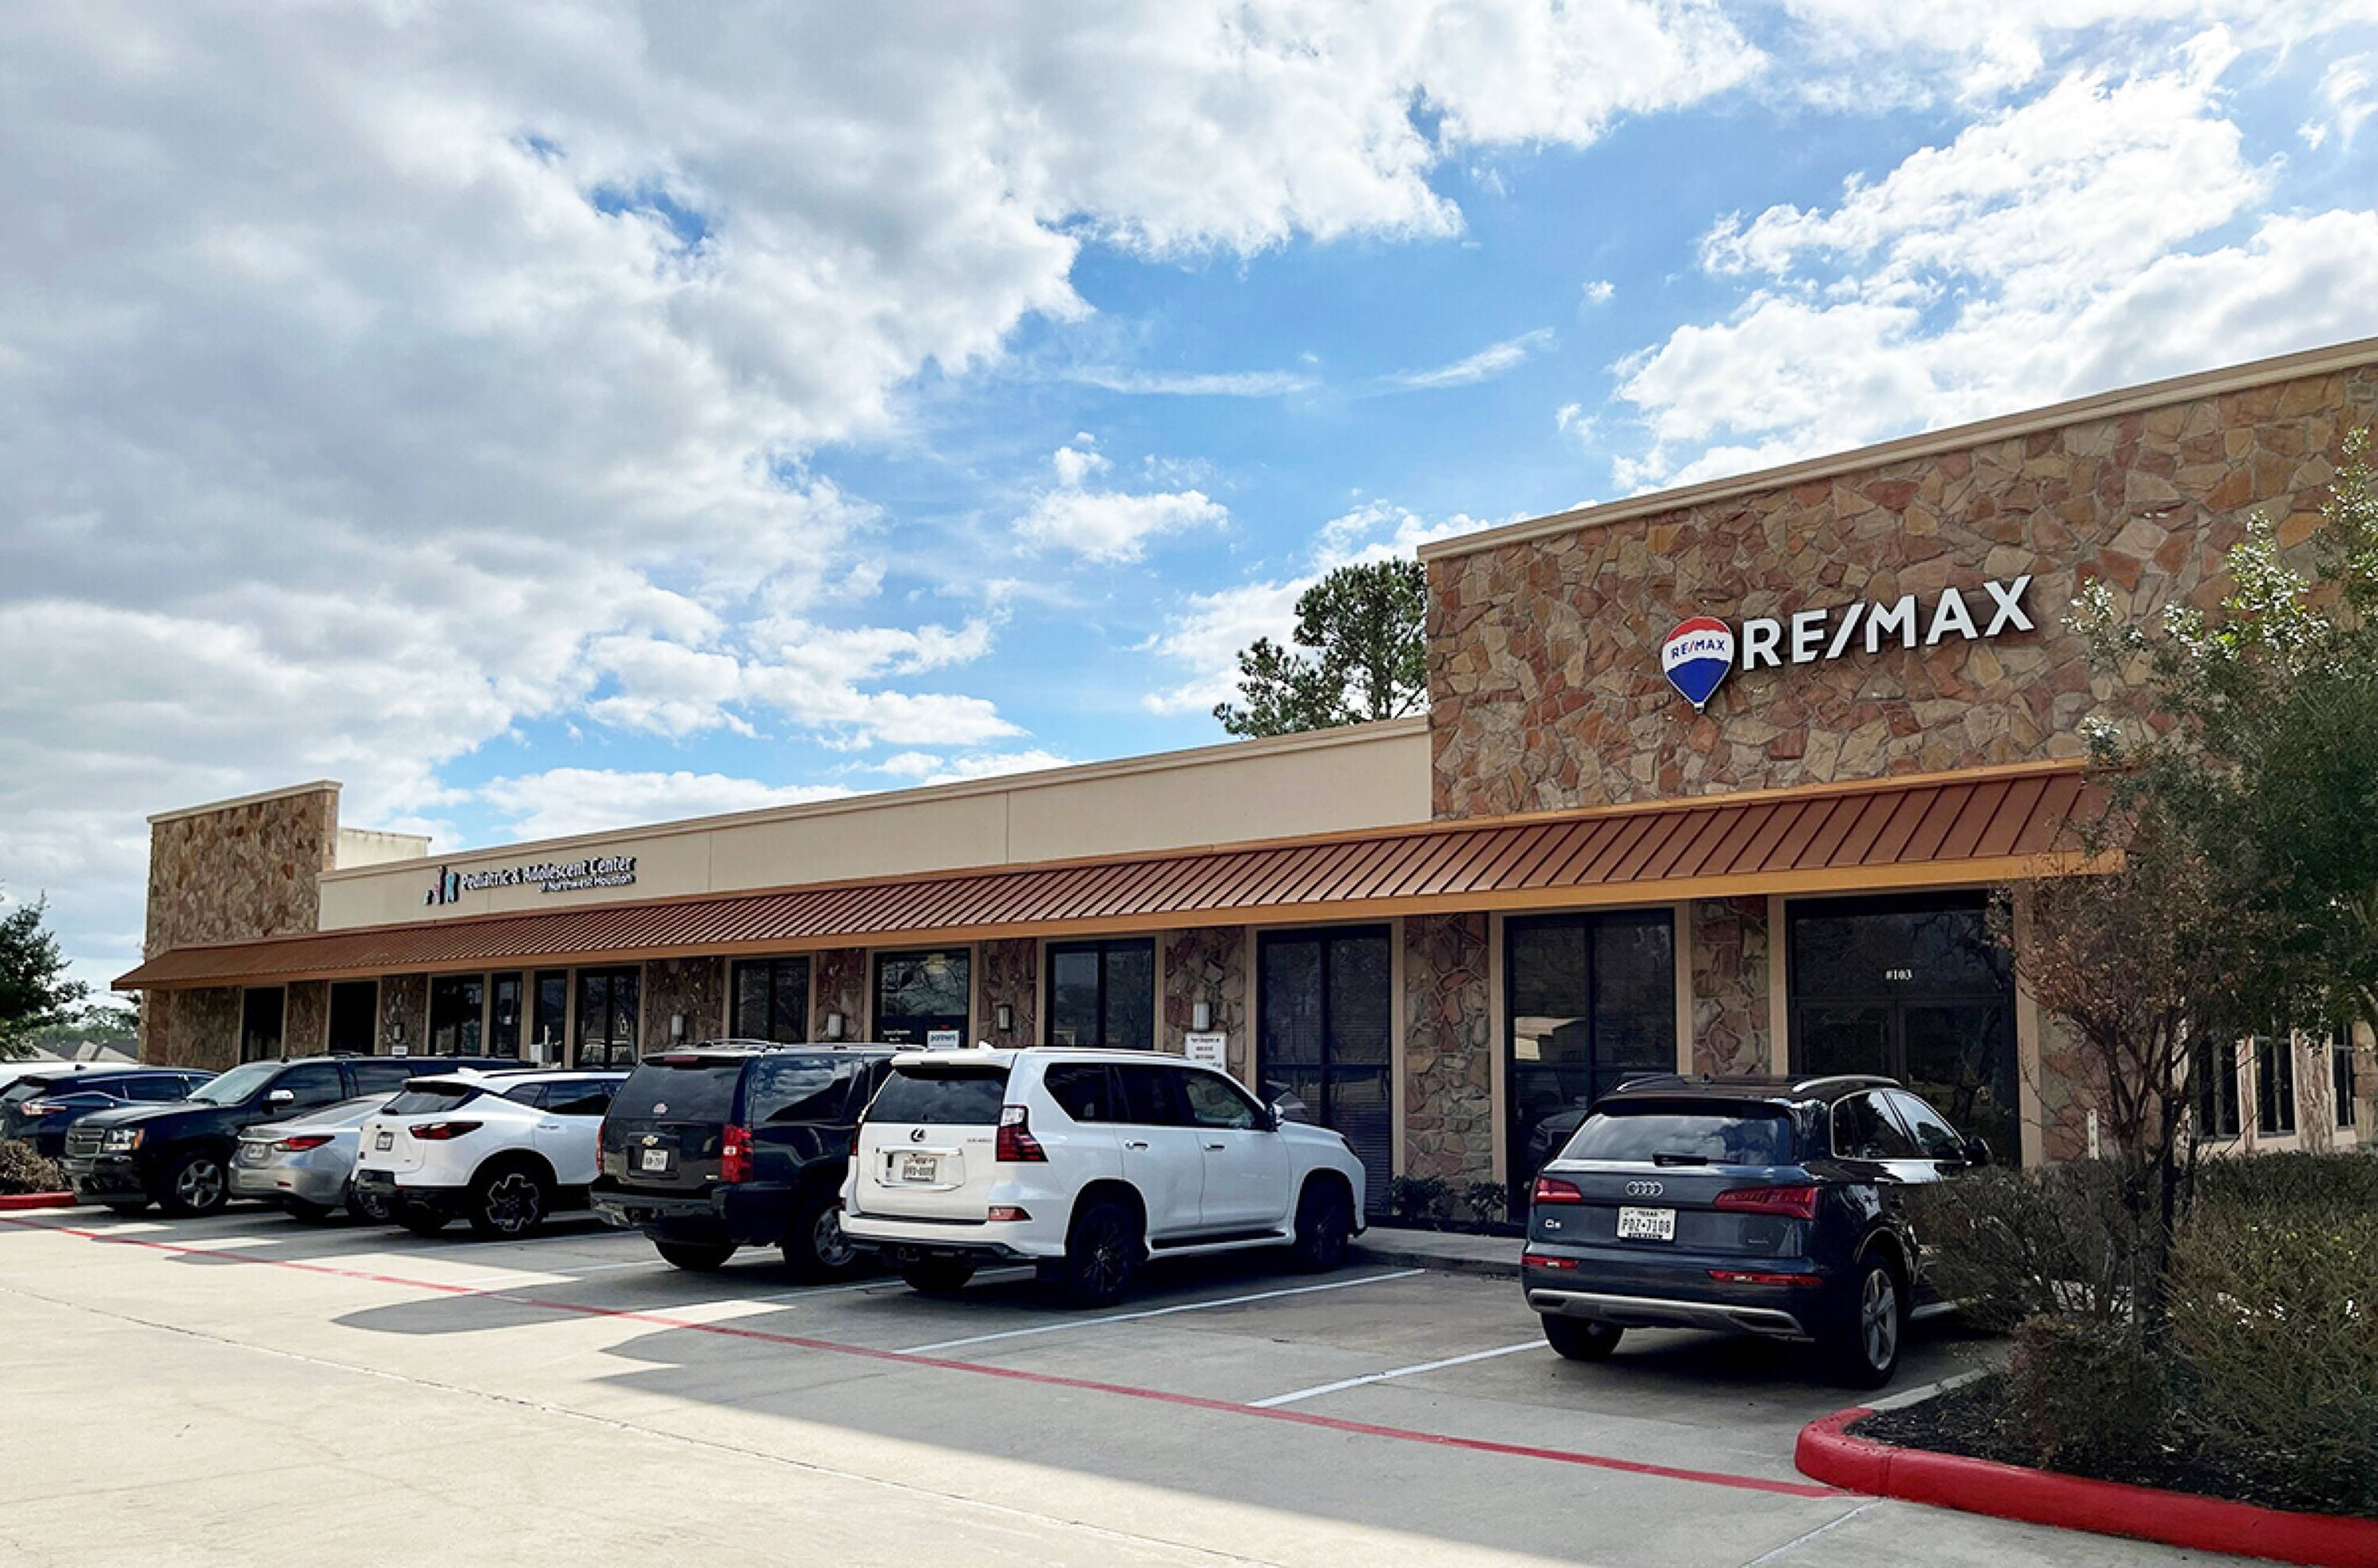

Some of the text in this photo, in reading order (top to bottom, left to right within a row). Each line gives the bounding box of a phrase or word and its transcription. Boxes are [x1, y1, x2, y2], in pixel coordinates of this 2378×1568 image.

[1742, 574, 2036, 672] RE/MAX
[1669, 637, 1726, 660] RE/MAX
[590, 855, 637, 876] Center
[1886, 969, 1913, 981] #103
